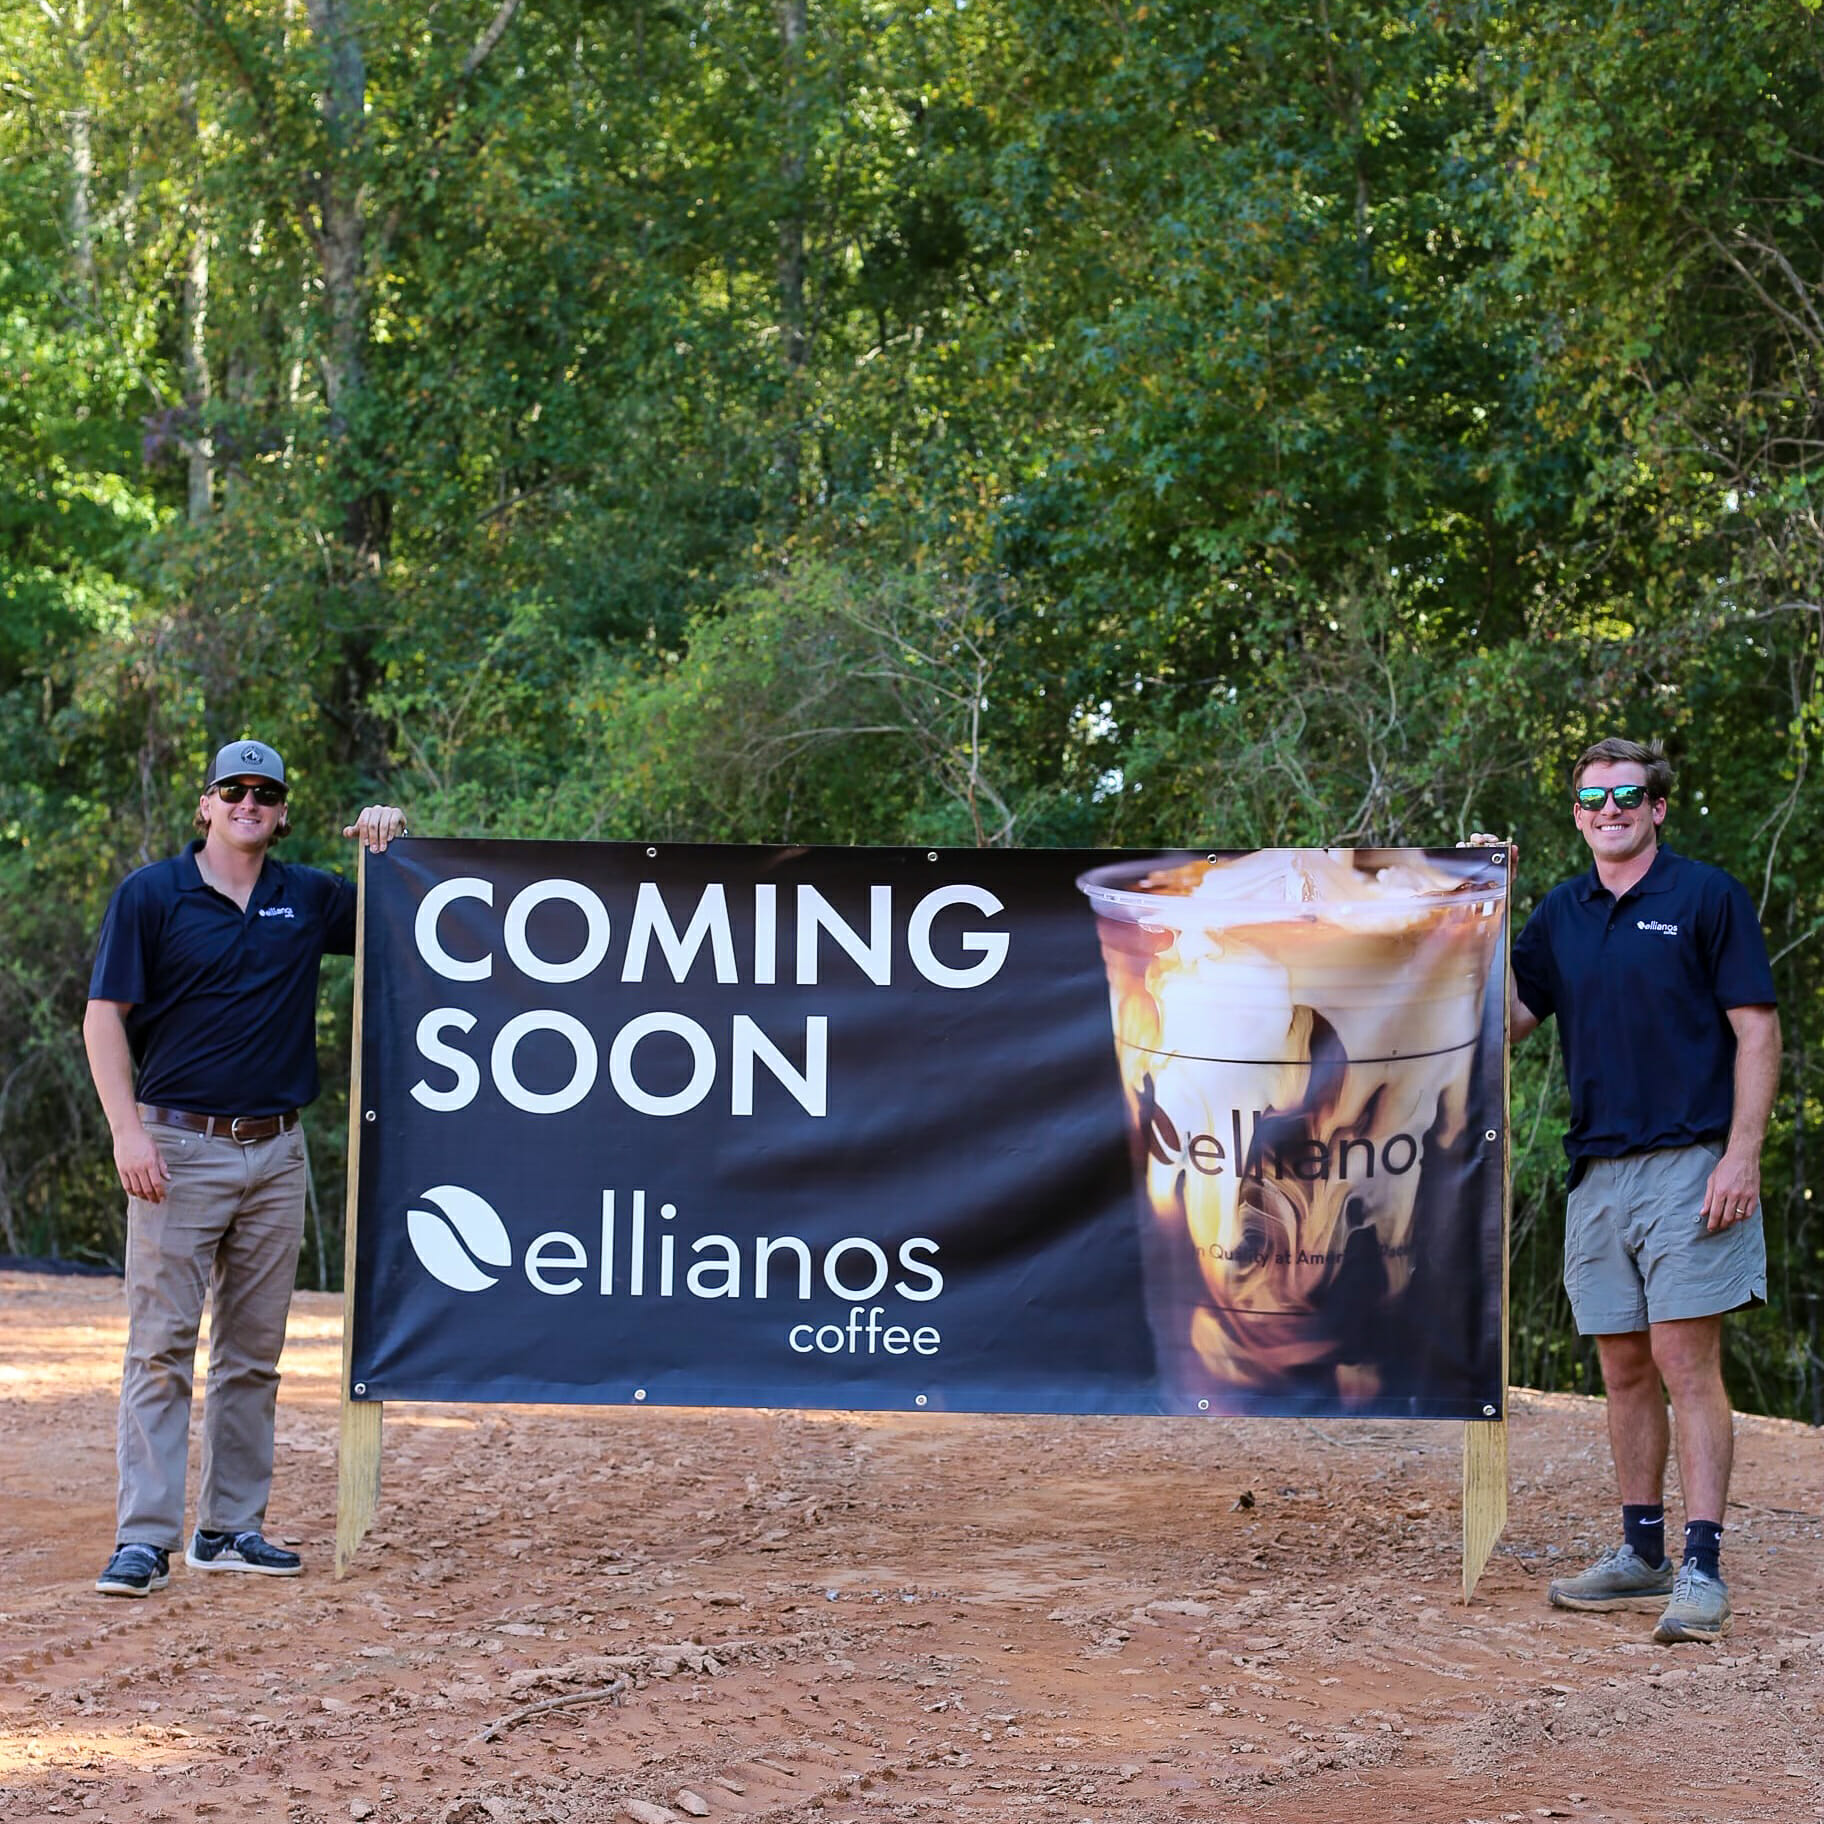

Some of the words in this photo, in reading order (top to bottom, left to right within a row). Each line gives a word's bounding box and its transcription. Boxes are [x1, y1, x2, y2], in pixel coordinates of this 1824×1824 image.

[413, 876, 1011, 989] COMING
[409, 1006, 829, 1118] SOON
[523, 1188, 945, 1302] ellianos
[1209, 1243, 1269, 1268] Quty
[1275, 1250, 1292, 1265] at
[788, 1306, 942, 1356] coffee
